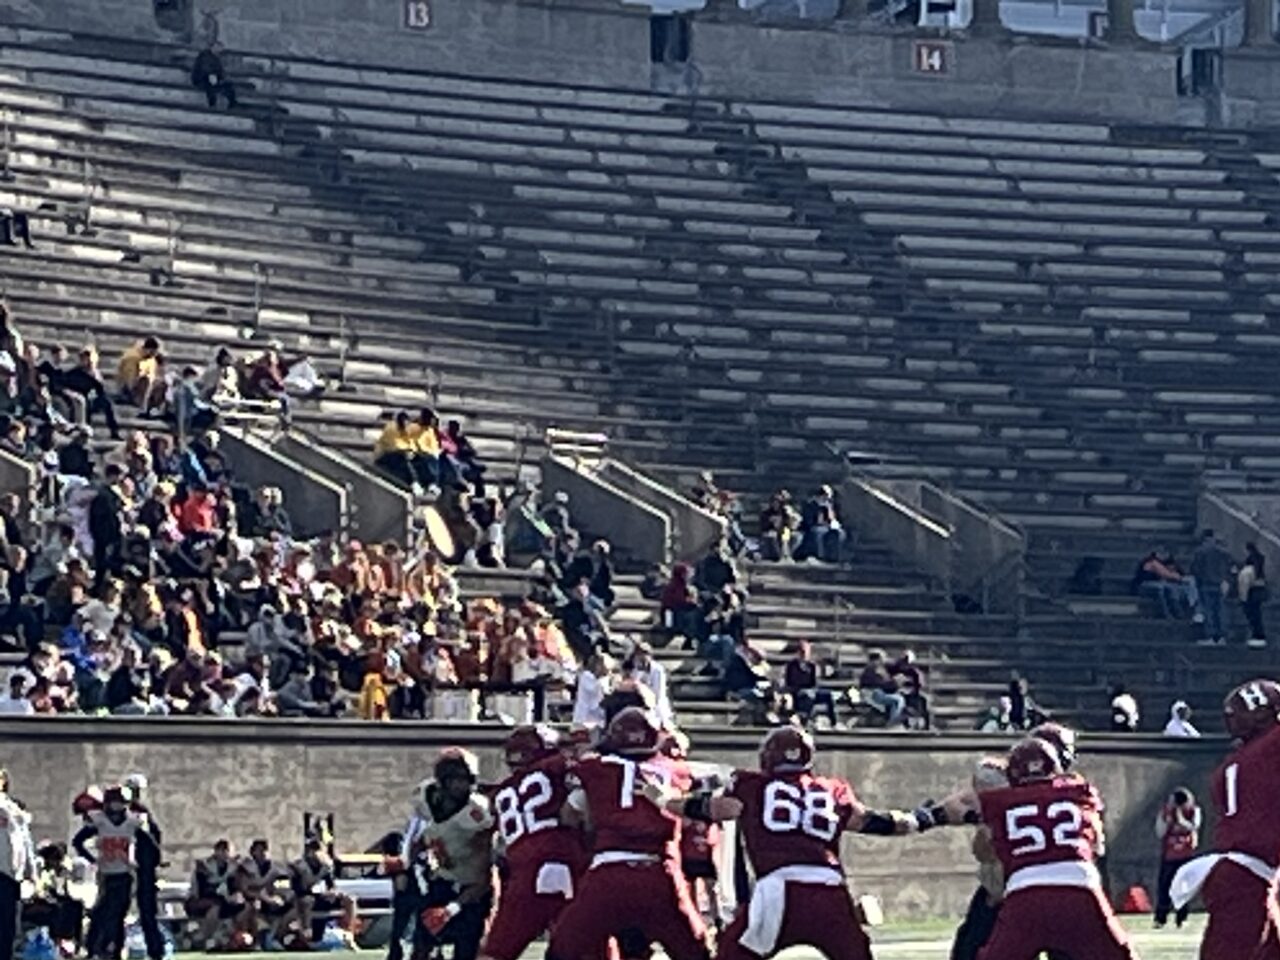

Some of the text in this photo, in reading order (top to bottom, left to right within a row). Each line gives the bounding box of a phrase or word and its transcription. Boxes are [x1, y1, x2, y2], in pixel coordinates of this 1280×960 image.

[407, 2, 430, 28] 13
[920, 46, 943, 71] 14
[1237, 681, 1269, 711] H
[495, 771, 558, 846] 82
[762, 780, 839, 842] 68
[1225, 763, 1239, 816] 1
[1005, 800, 1085, 856] 52
